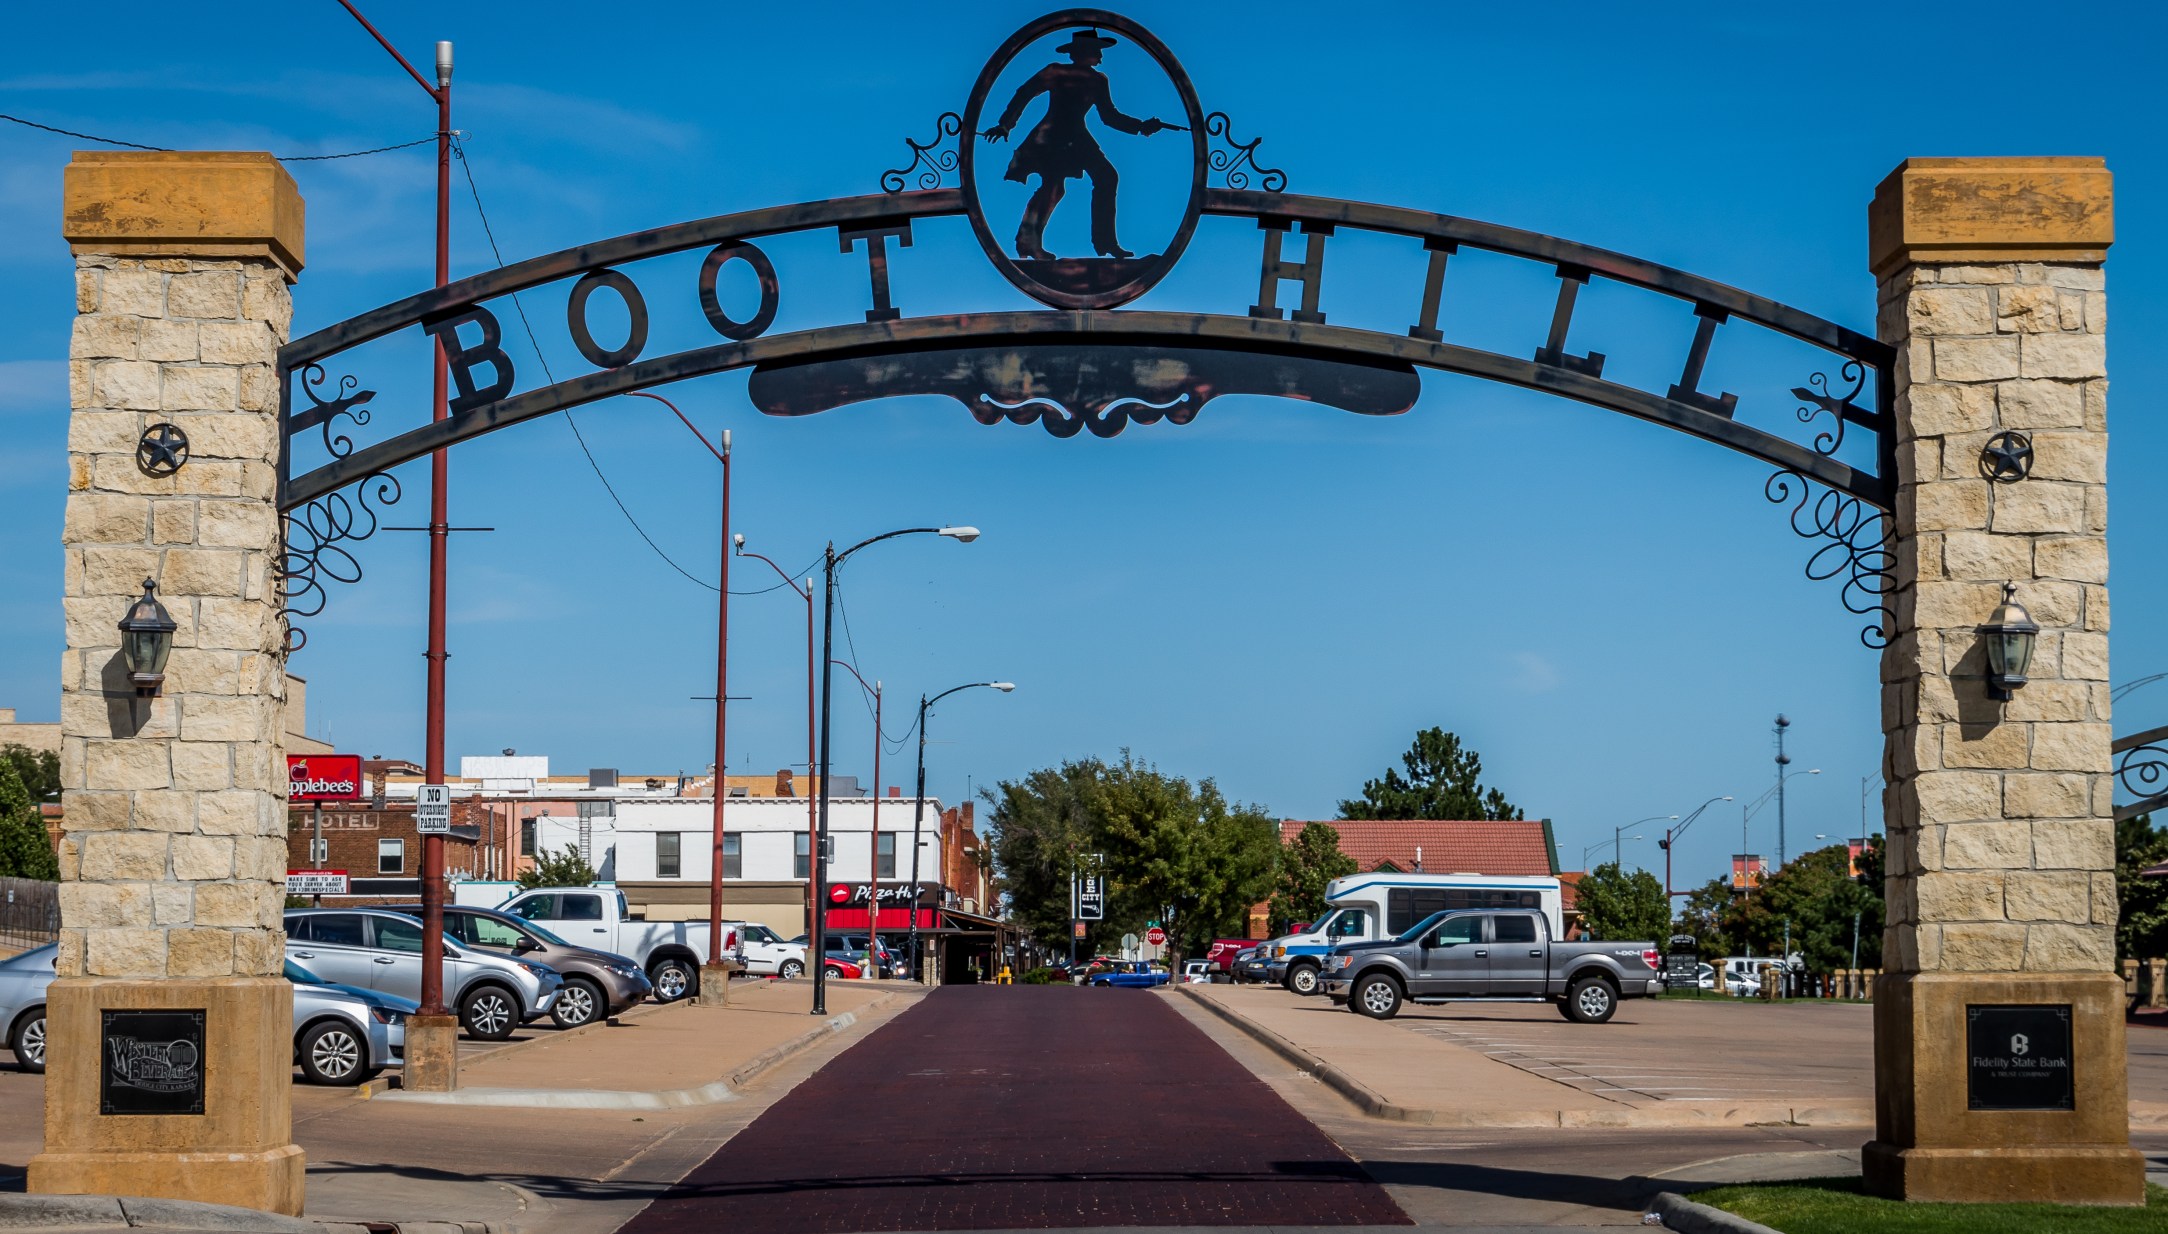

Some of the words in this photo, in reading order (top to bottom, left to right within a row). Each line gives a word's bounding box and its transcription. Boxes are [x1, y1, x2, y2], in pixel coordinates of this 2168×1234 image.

[421, 217, 914, 415] BOOT
[1249, 215, 1739, 420] HILL
[288, 778, 354, 796] pplebee's
[427, 788, 441, 802] NO
[420, 804, 448, 816] OVERNIGHT
[304, 813, 375, 829] HOTEL
[420, 817, 447, 829] PARKING
[1081, 893, 1100, 902] CITY
[1148, 932, 1164, 941] STOP
[1973, 1056, 2009, 1070] Fidelity
[2011, 1057, 2037, 1068] State
[2039, 1056, 2067, 1068] Bank
